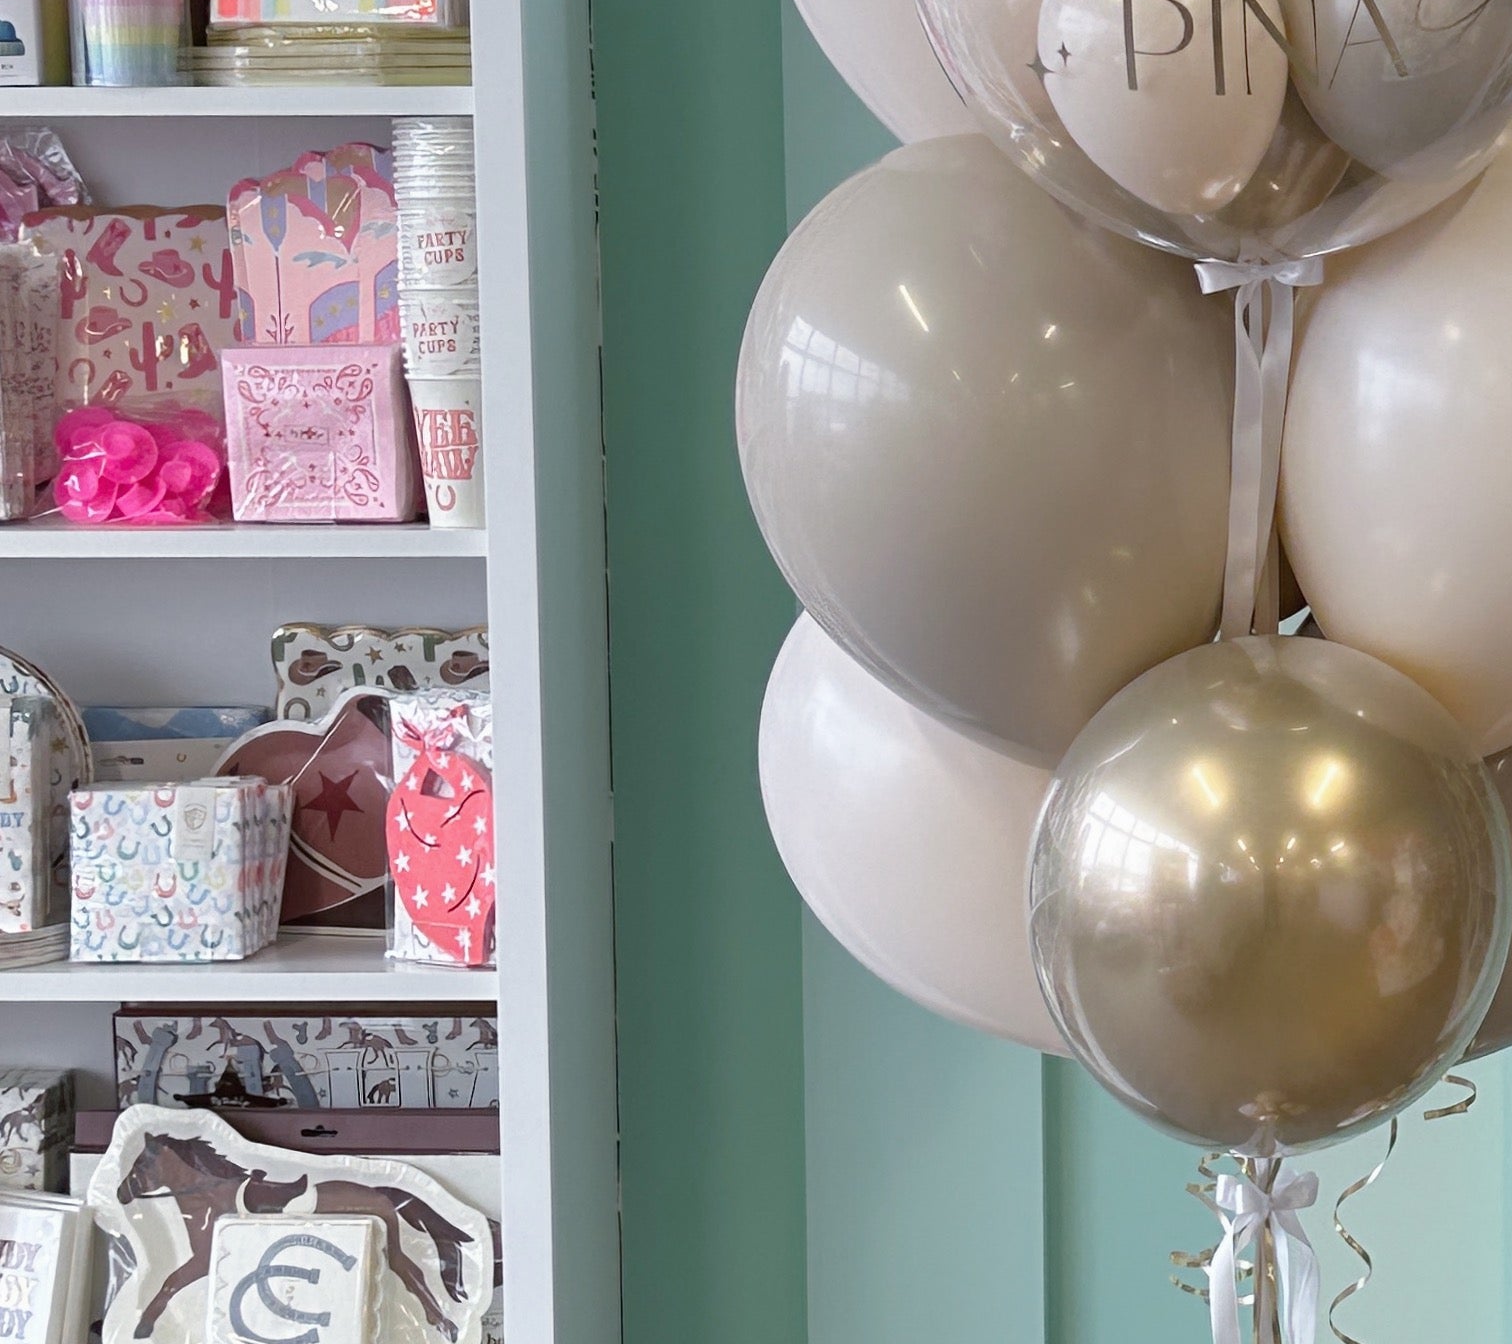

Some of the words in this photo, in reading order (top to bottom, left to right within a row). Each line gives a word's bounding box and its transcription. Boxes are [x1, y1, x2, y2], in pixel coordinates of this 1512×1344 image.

[417, 229, 468, 249] PARTY
[424, 248, 465, 266] CUPS
[412, 315, 460, 338] PARTY
[418, 339, 457, 355] CUPS
